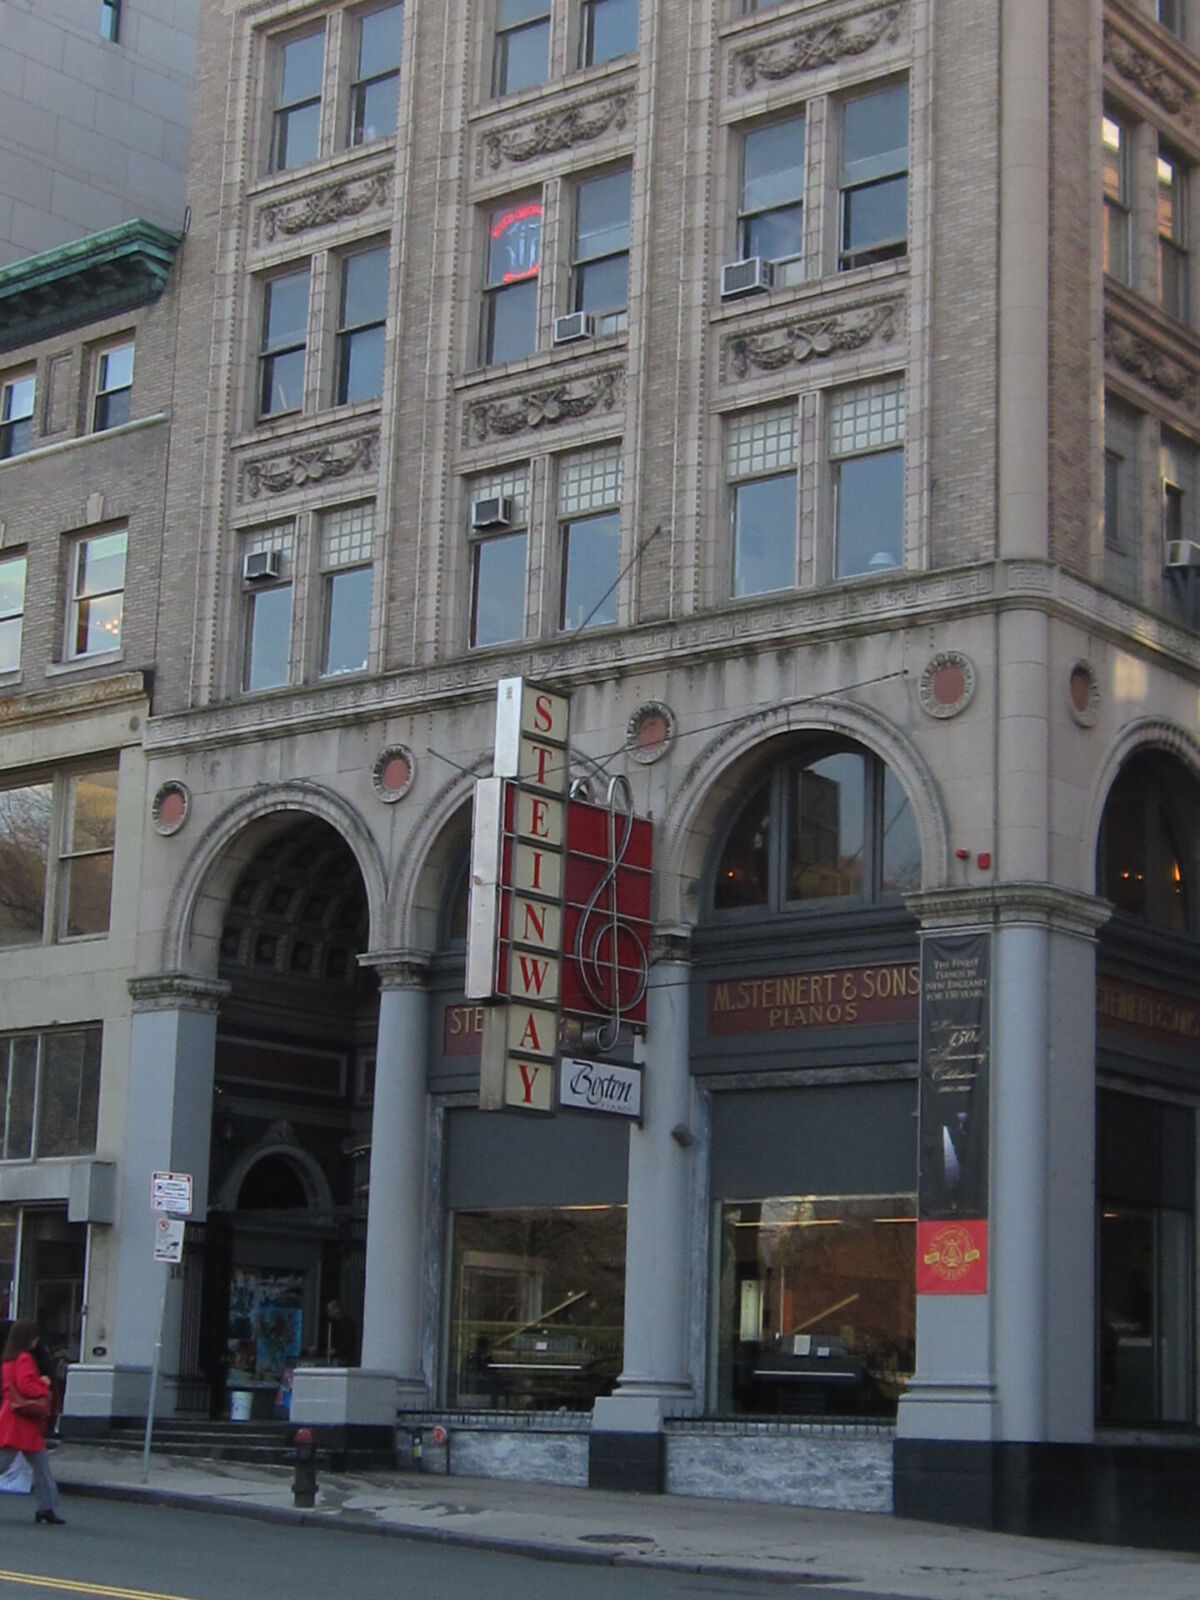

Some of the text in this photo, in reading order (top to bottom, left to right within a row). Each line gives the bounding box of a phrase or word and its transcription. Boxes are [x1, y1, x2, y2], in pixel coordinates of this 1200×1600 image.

[518, 695, 554, 1104] STEINWAY
[862, 967, 920, 999] SONS
[769, 1002, 858, 1027] PIANOS
[570, 1060, 633, 1105] Boston
